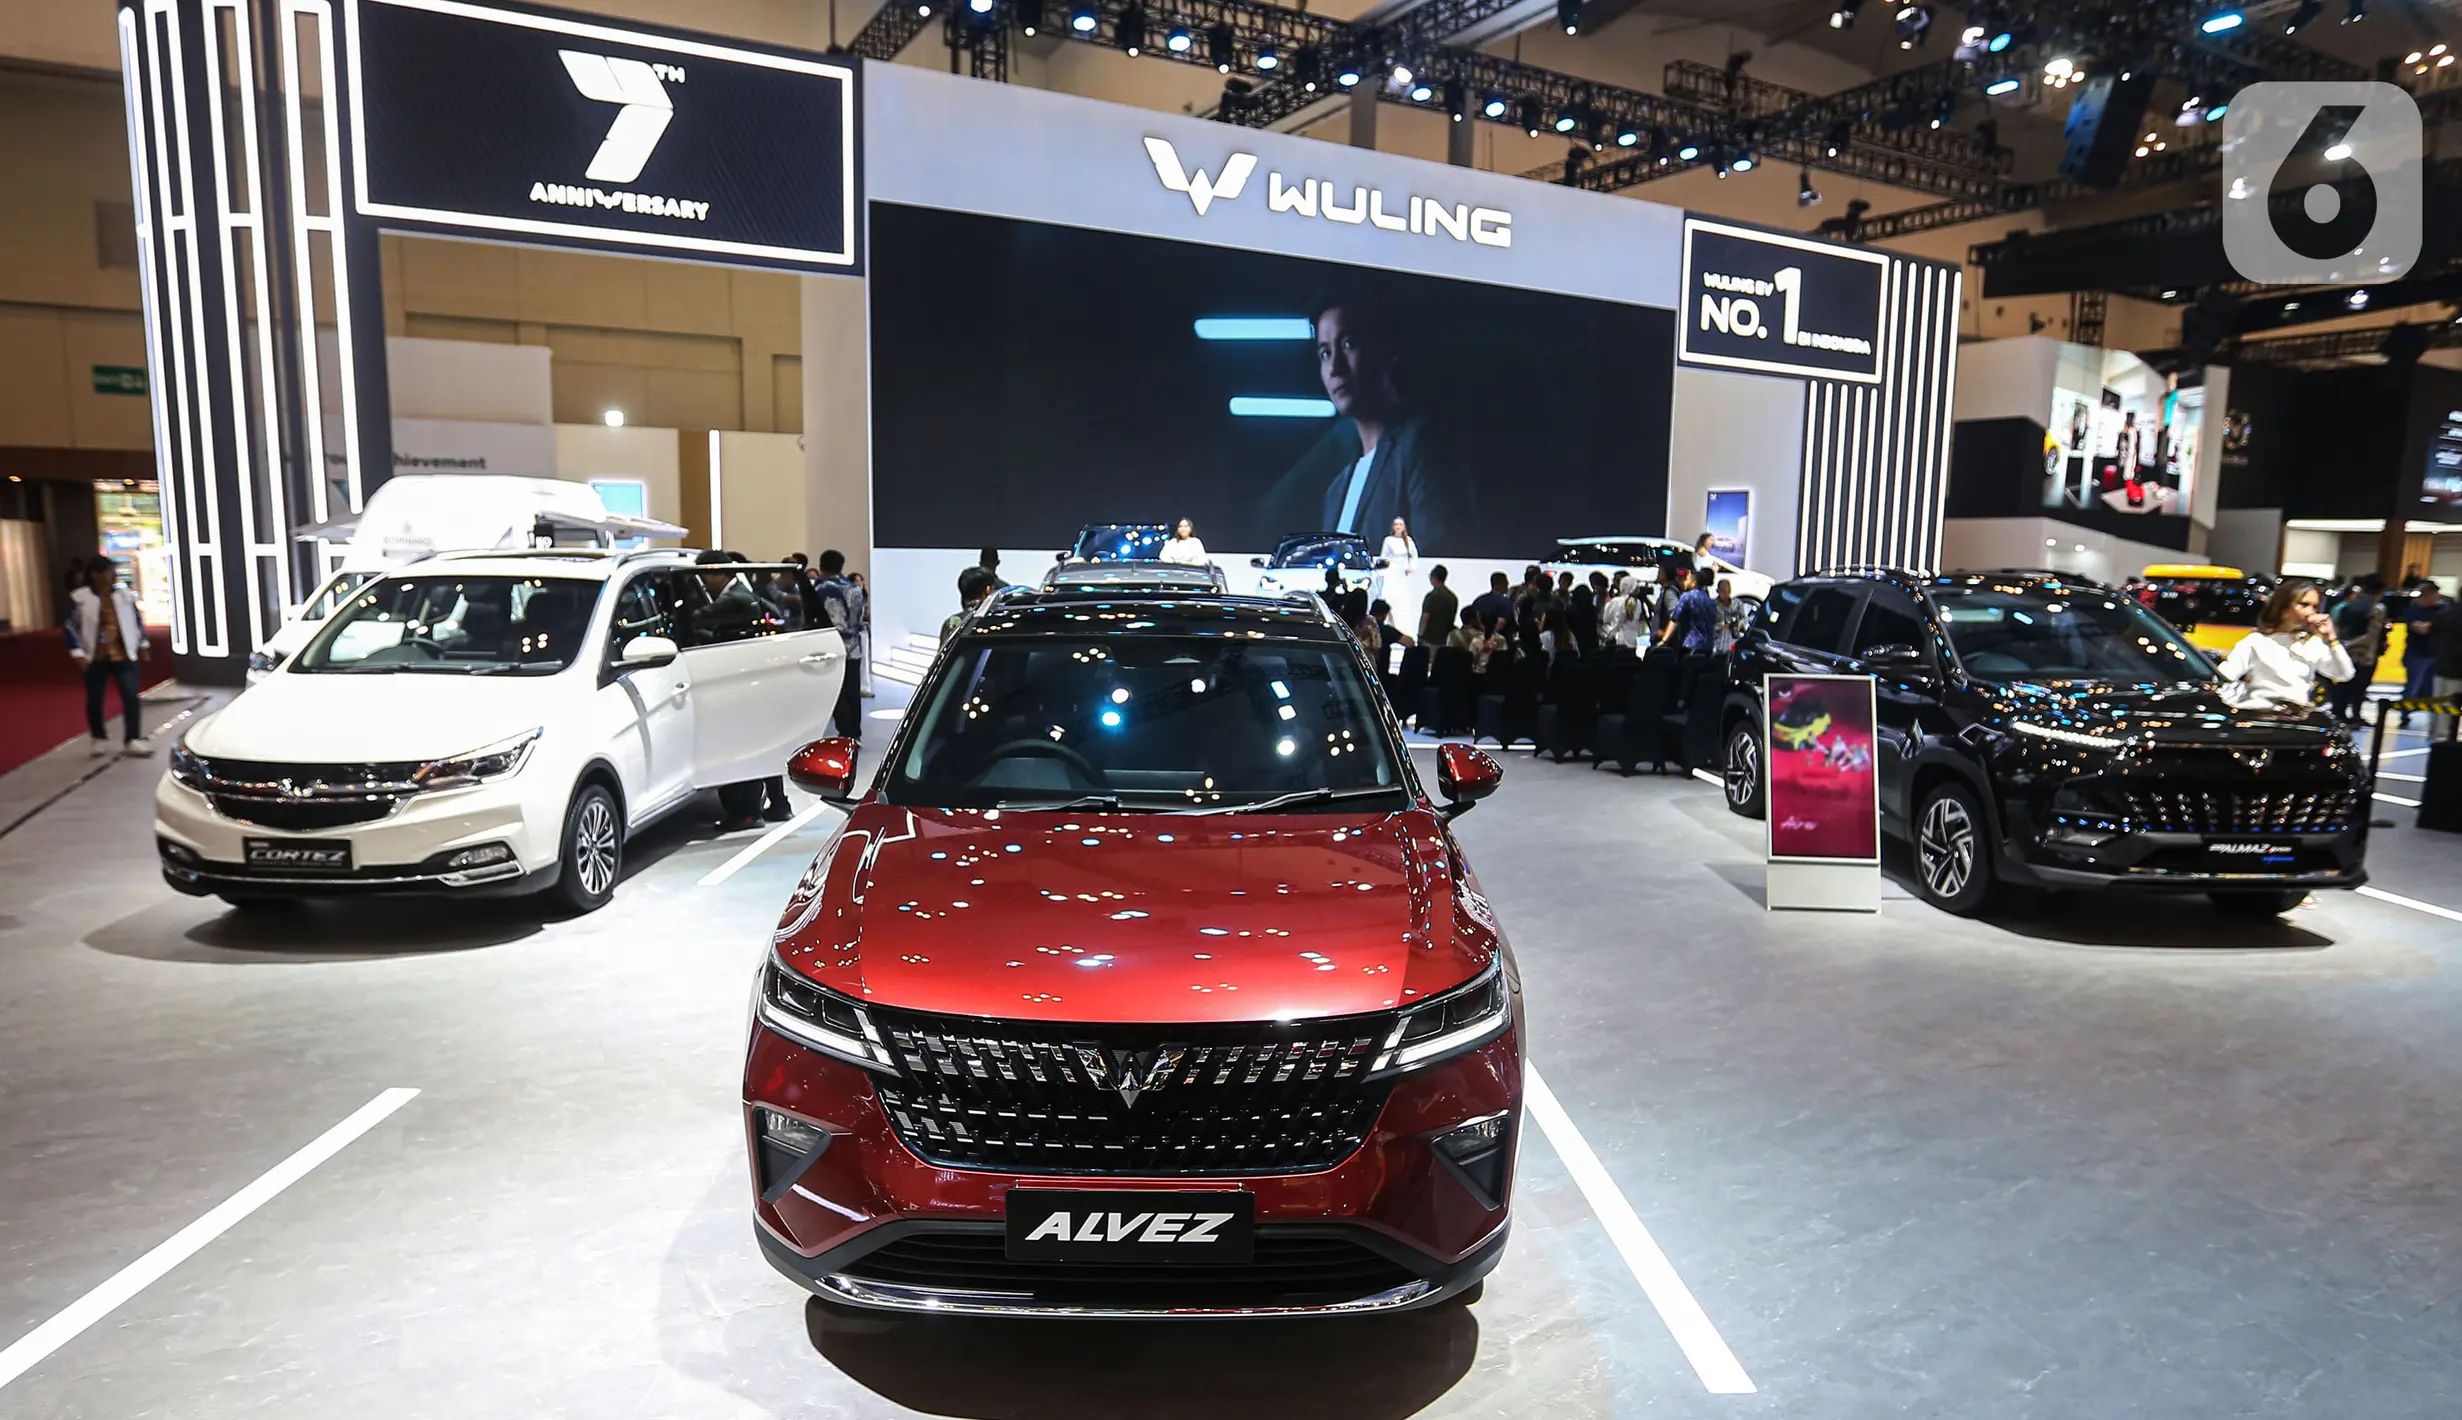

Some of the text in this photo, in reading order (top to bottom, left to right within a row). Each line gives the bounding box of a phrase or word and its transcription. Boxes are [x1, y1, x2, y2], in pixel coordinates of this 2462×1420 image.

[530, 182, 710, 221] ANNIVERSARY
[1268, 172, 1512, 247] WULING
[1701, 267, 1801, 345] NO. 1
[250, 849, 346, 861] CORTEZ
[1025, 1212, 1234, 1242] ALVEZ
